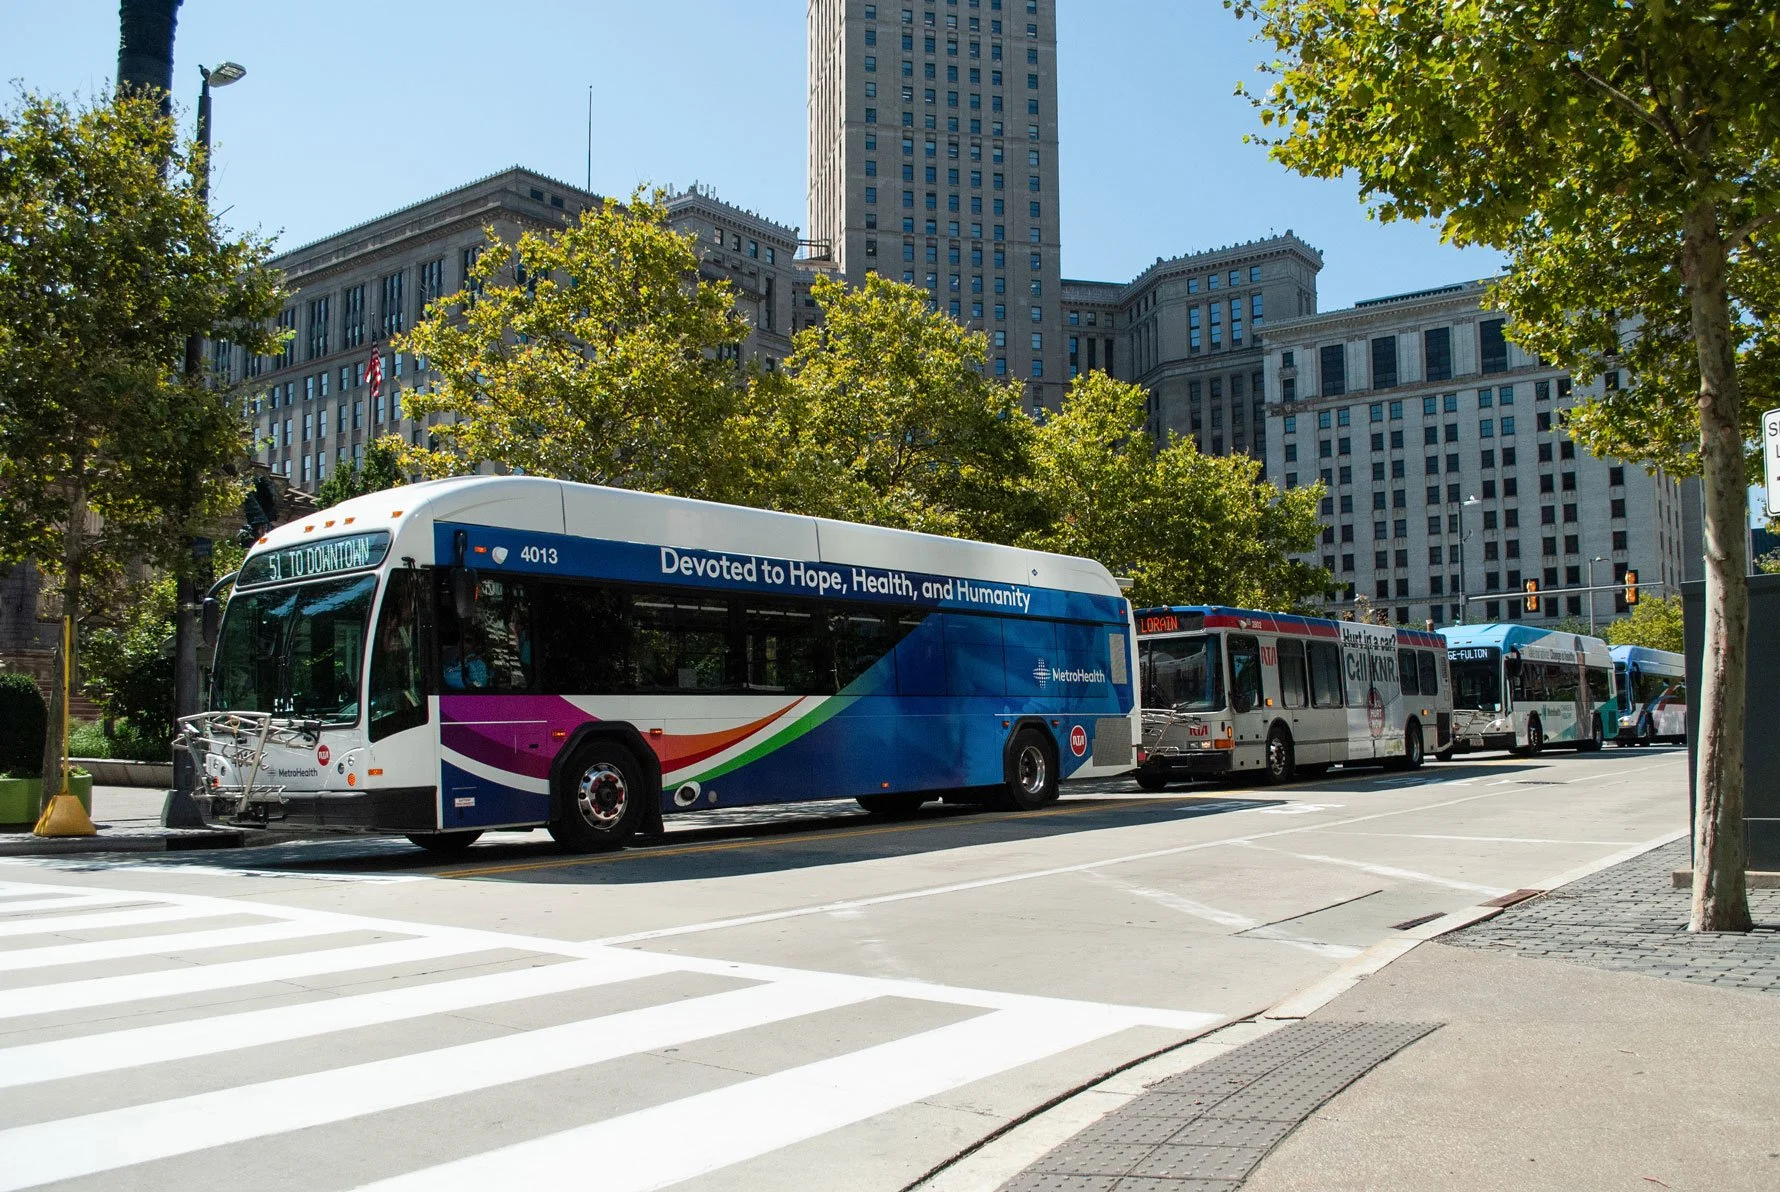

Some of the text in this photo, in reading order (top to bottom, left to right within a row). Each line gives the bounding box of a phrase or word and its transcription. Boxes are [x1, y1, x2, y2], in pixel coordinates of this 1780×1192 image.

[1768, 421, 1780, 437] S
[268, 537, 369, 580] 51 TO DOWNTOWN
[520, 545, 558, 565] 4013
[660, 547, 1031, 613] Devoted to Hope, Health, and Humanity
[1140, 616, 1178, 633] LORAIN
[1343, 628, 1361, 648] Hurt
[1261, 646, 1277, 666] RTA
[1052, 667, 1105, 683] MetroHealth
[1346, 653, 1367, 681] Call
[1072, 735, 1085, 746] RTA
[278, 768, 318, 778] MetroHealth
